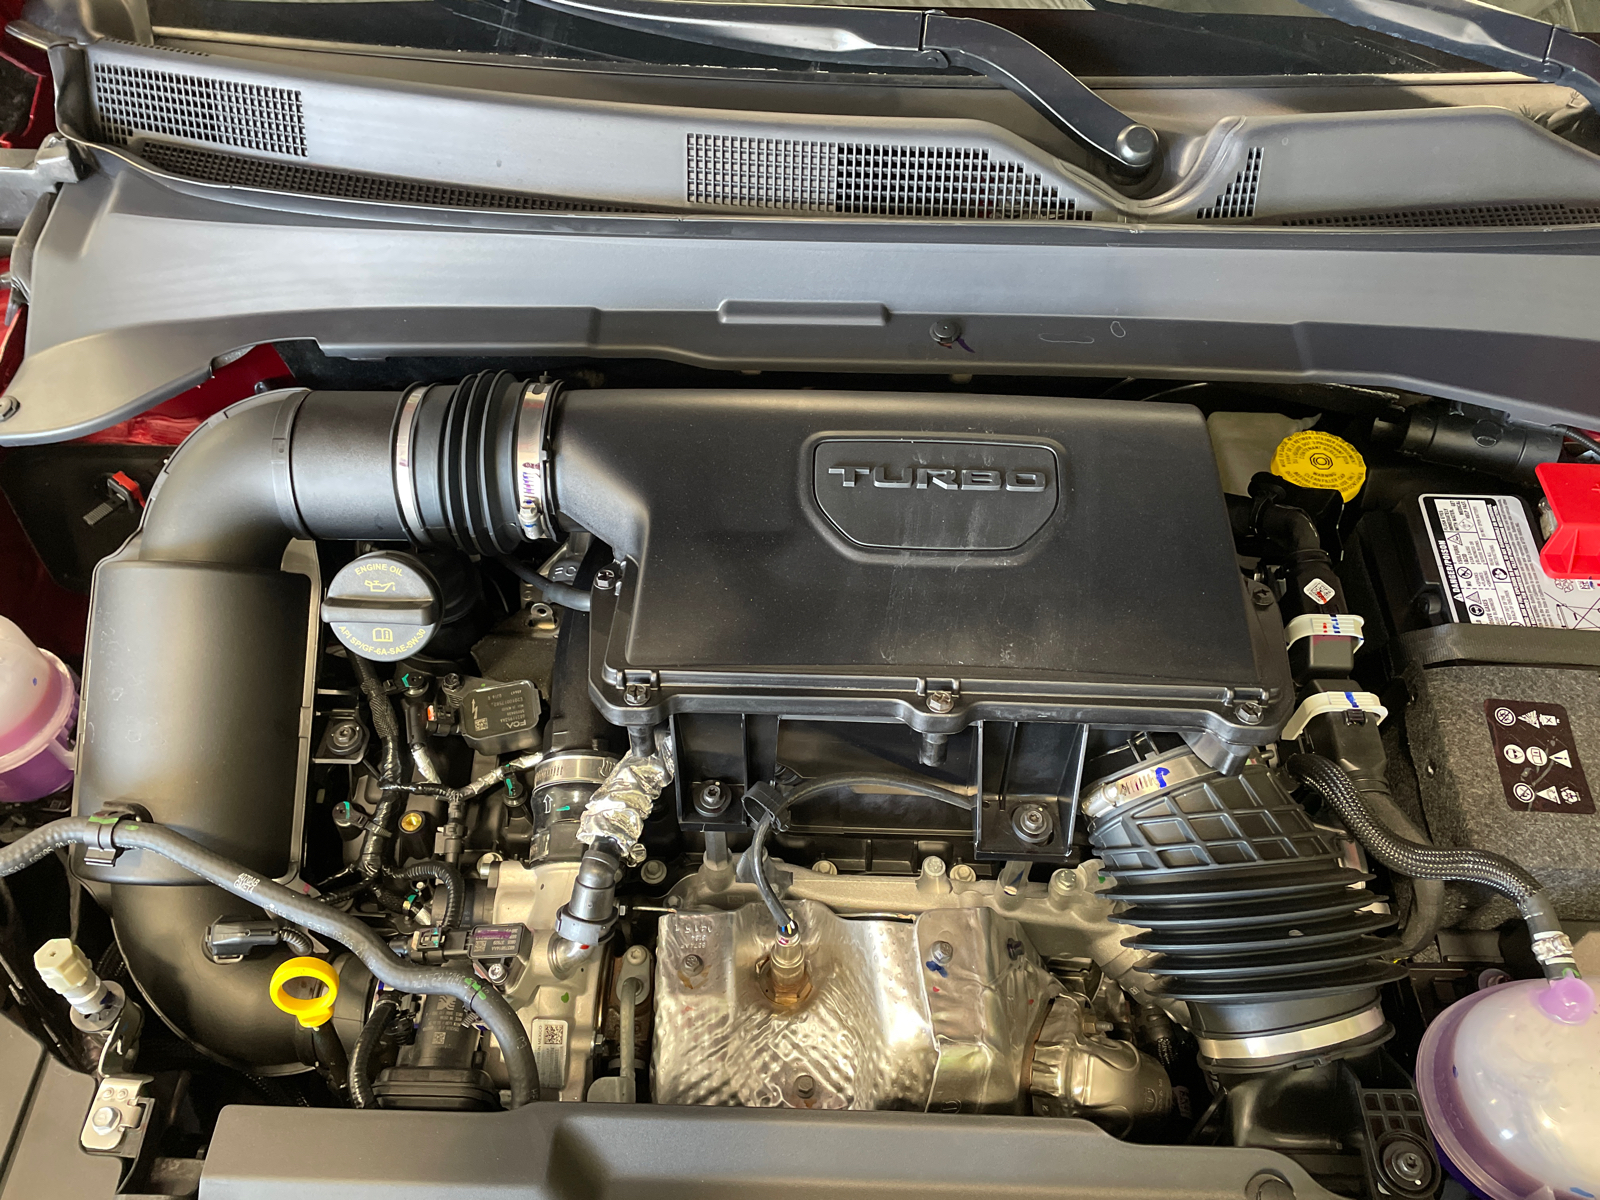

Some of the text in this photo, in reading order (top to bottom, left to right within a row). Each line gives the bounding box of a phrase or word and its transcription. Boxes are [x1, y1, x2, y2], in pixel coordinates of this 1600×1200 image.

[828, 465, 1046, 492] TURBO
[354, 563, 403, 576] ENGINE OIL
[338, 626, 426, 655] API SP/GF-6A-SAE-5W-30
[506, 719, 527, 729] FCA
